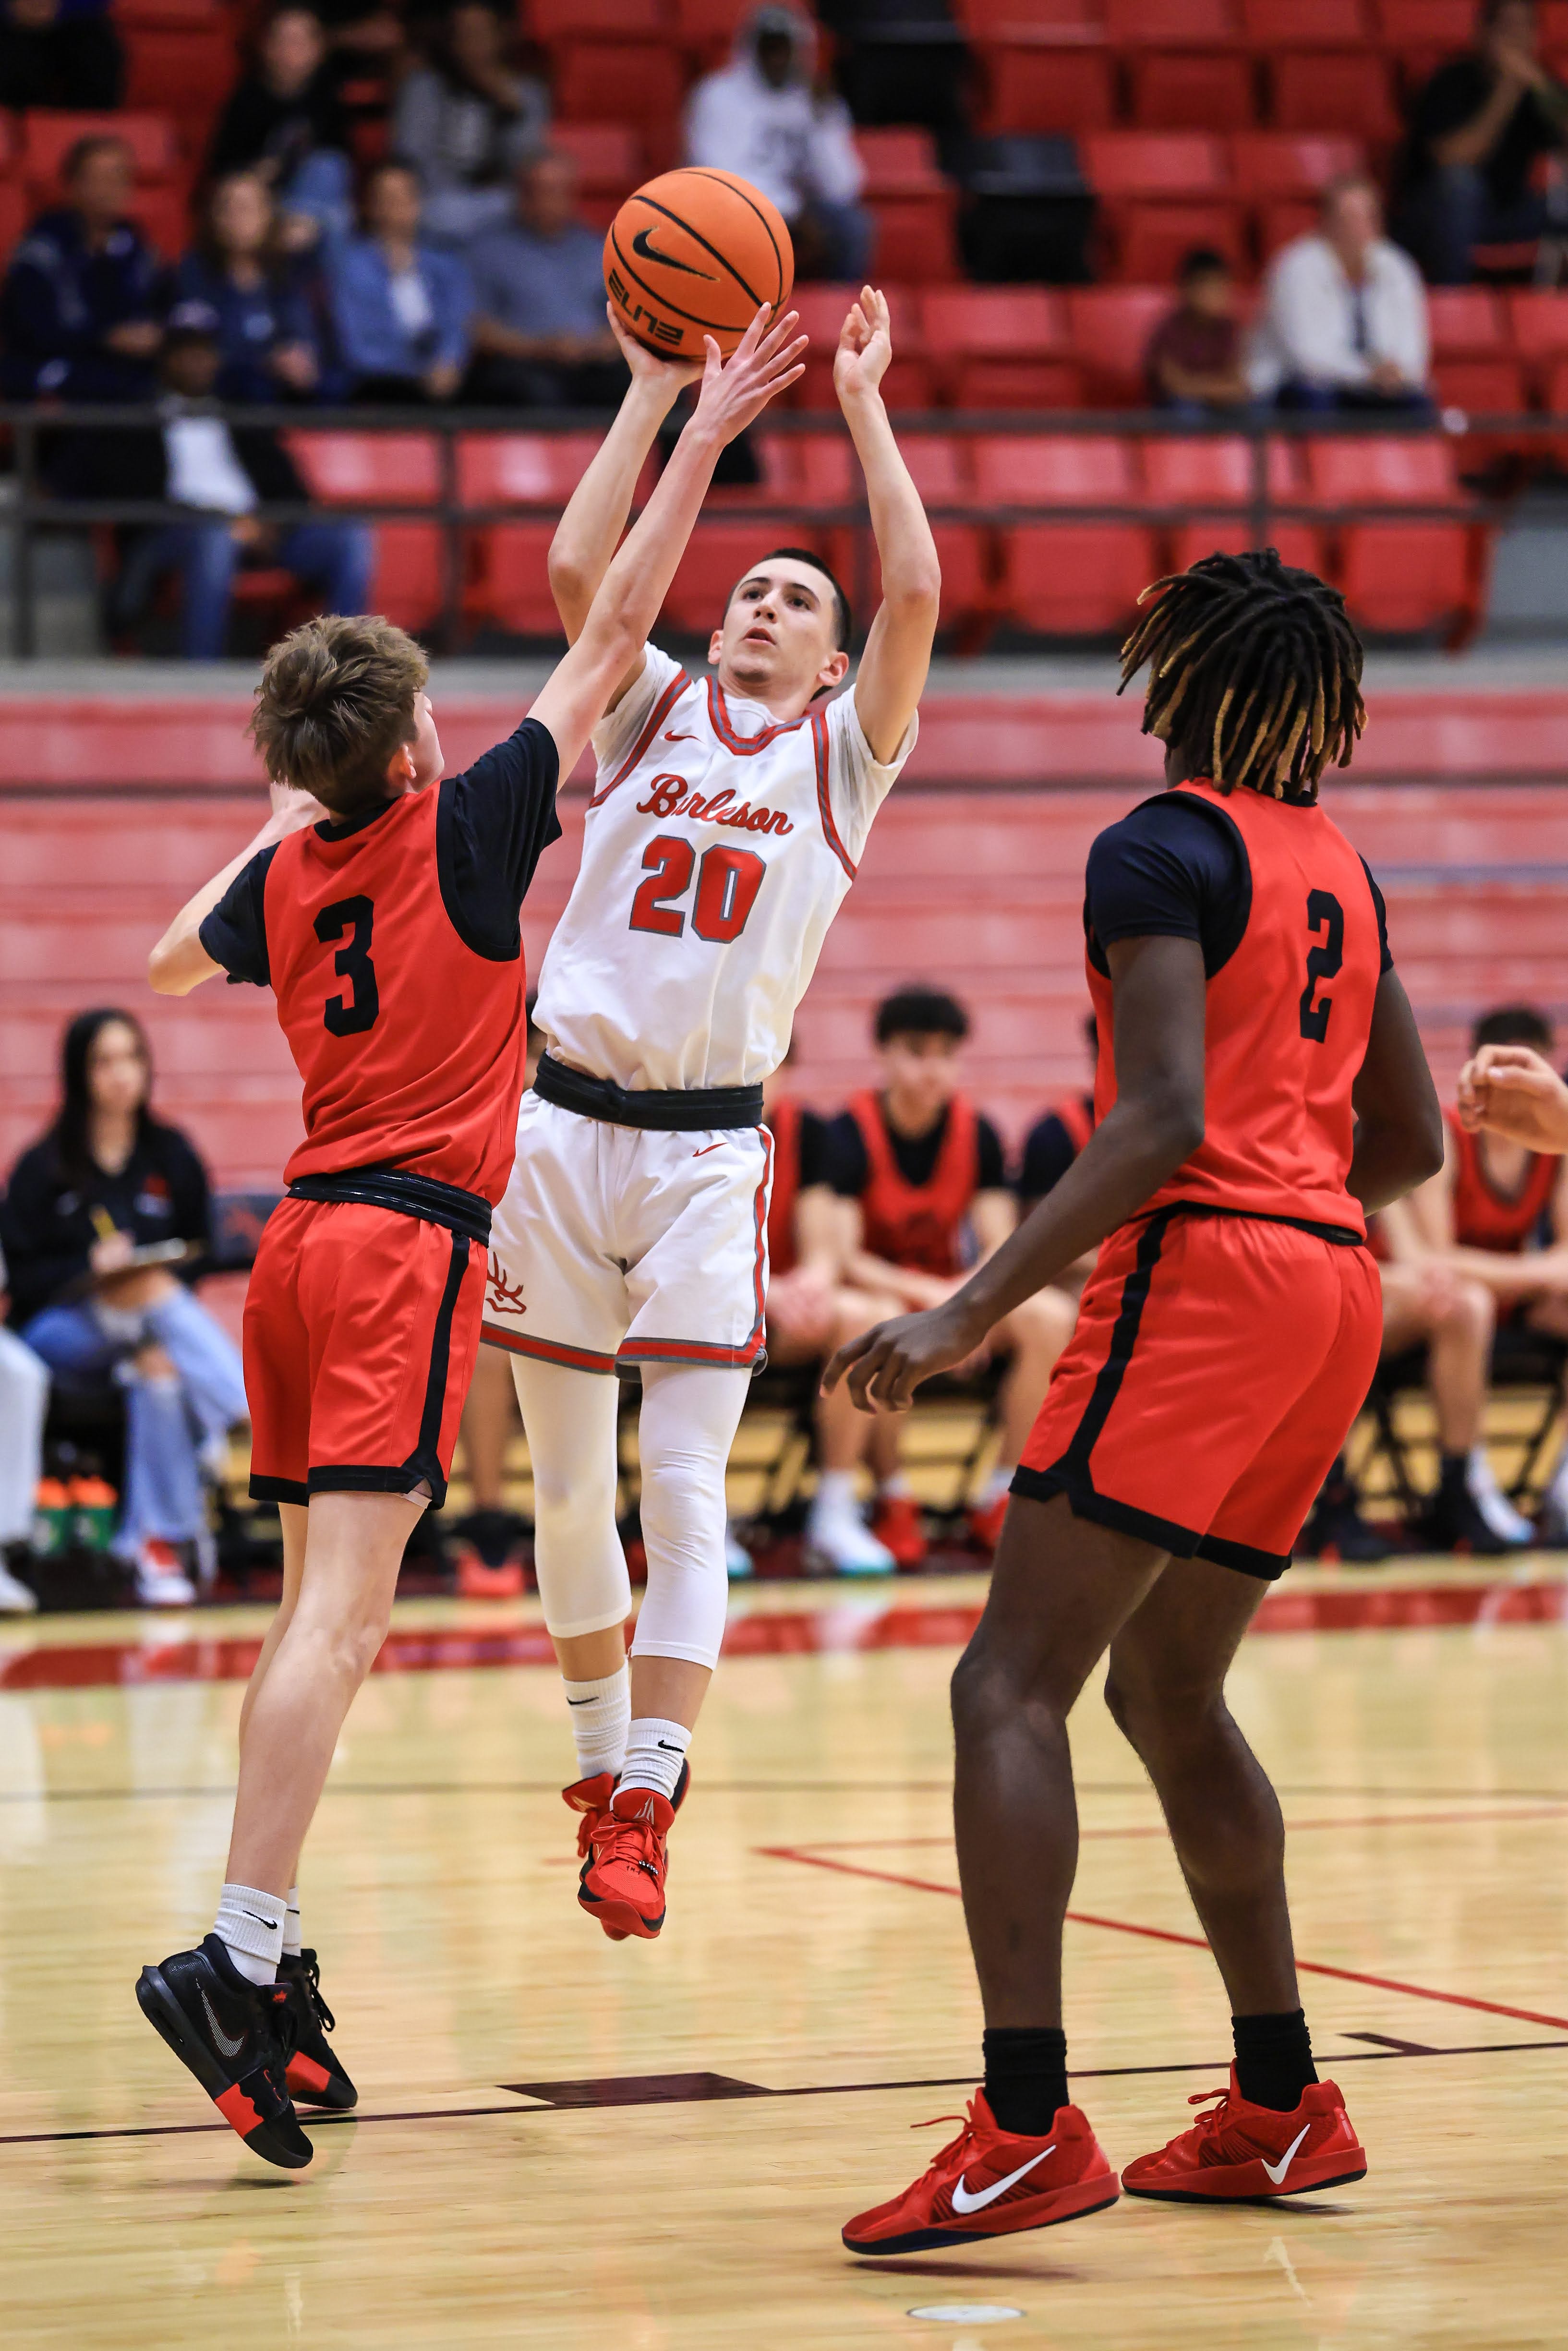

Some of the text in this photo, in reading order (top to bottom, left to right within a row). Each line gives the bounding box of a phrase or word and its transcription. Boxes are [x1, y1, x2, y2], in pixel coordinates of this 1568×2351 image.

[609, 268, 684, 346] ELITE
[628, 835, 767, 945] 20
[313, 894, 379, 1037] 3
[1299, 888, 1344, 1043] 2
